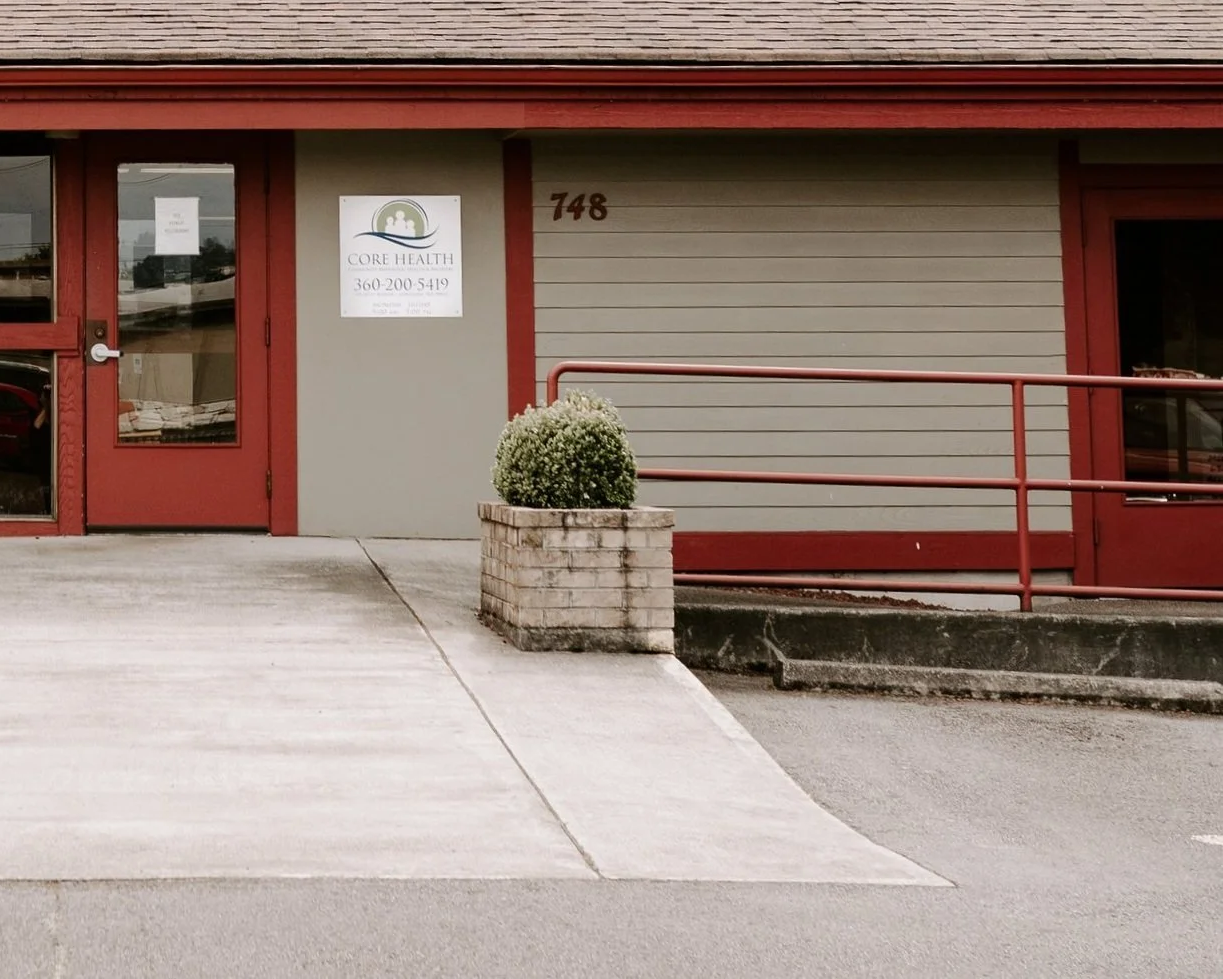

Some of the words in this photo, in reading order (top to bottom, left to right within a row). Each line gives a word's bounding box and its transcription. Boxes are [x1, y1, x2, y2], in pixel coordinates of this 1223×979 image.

[550, 192, 608, 221] 748
[347, 253, 389, 265] CORE
[395, 253, 454, 265] HEALTH
